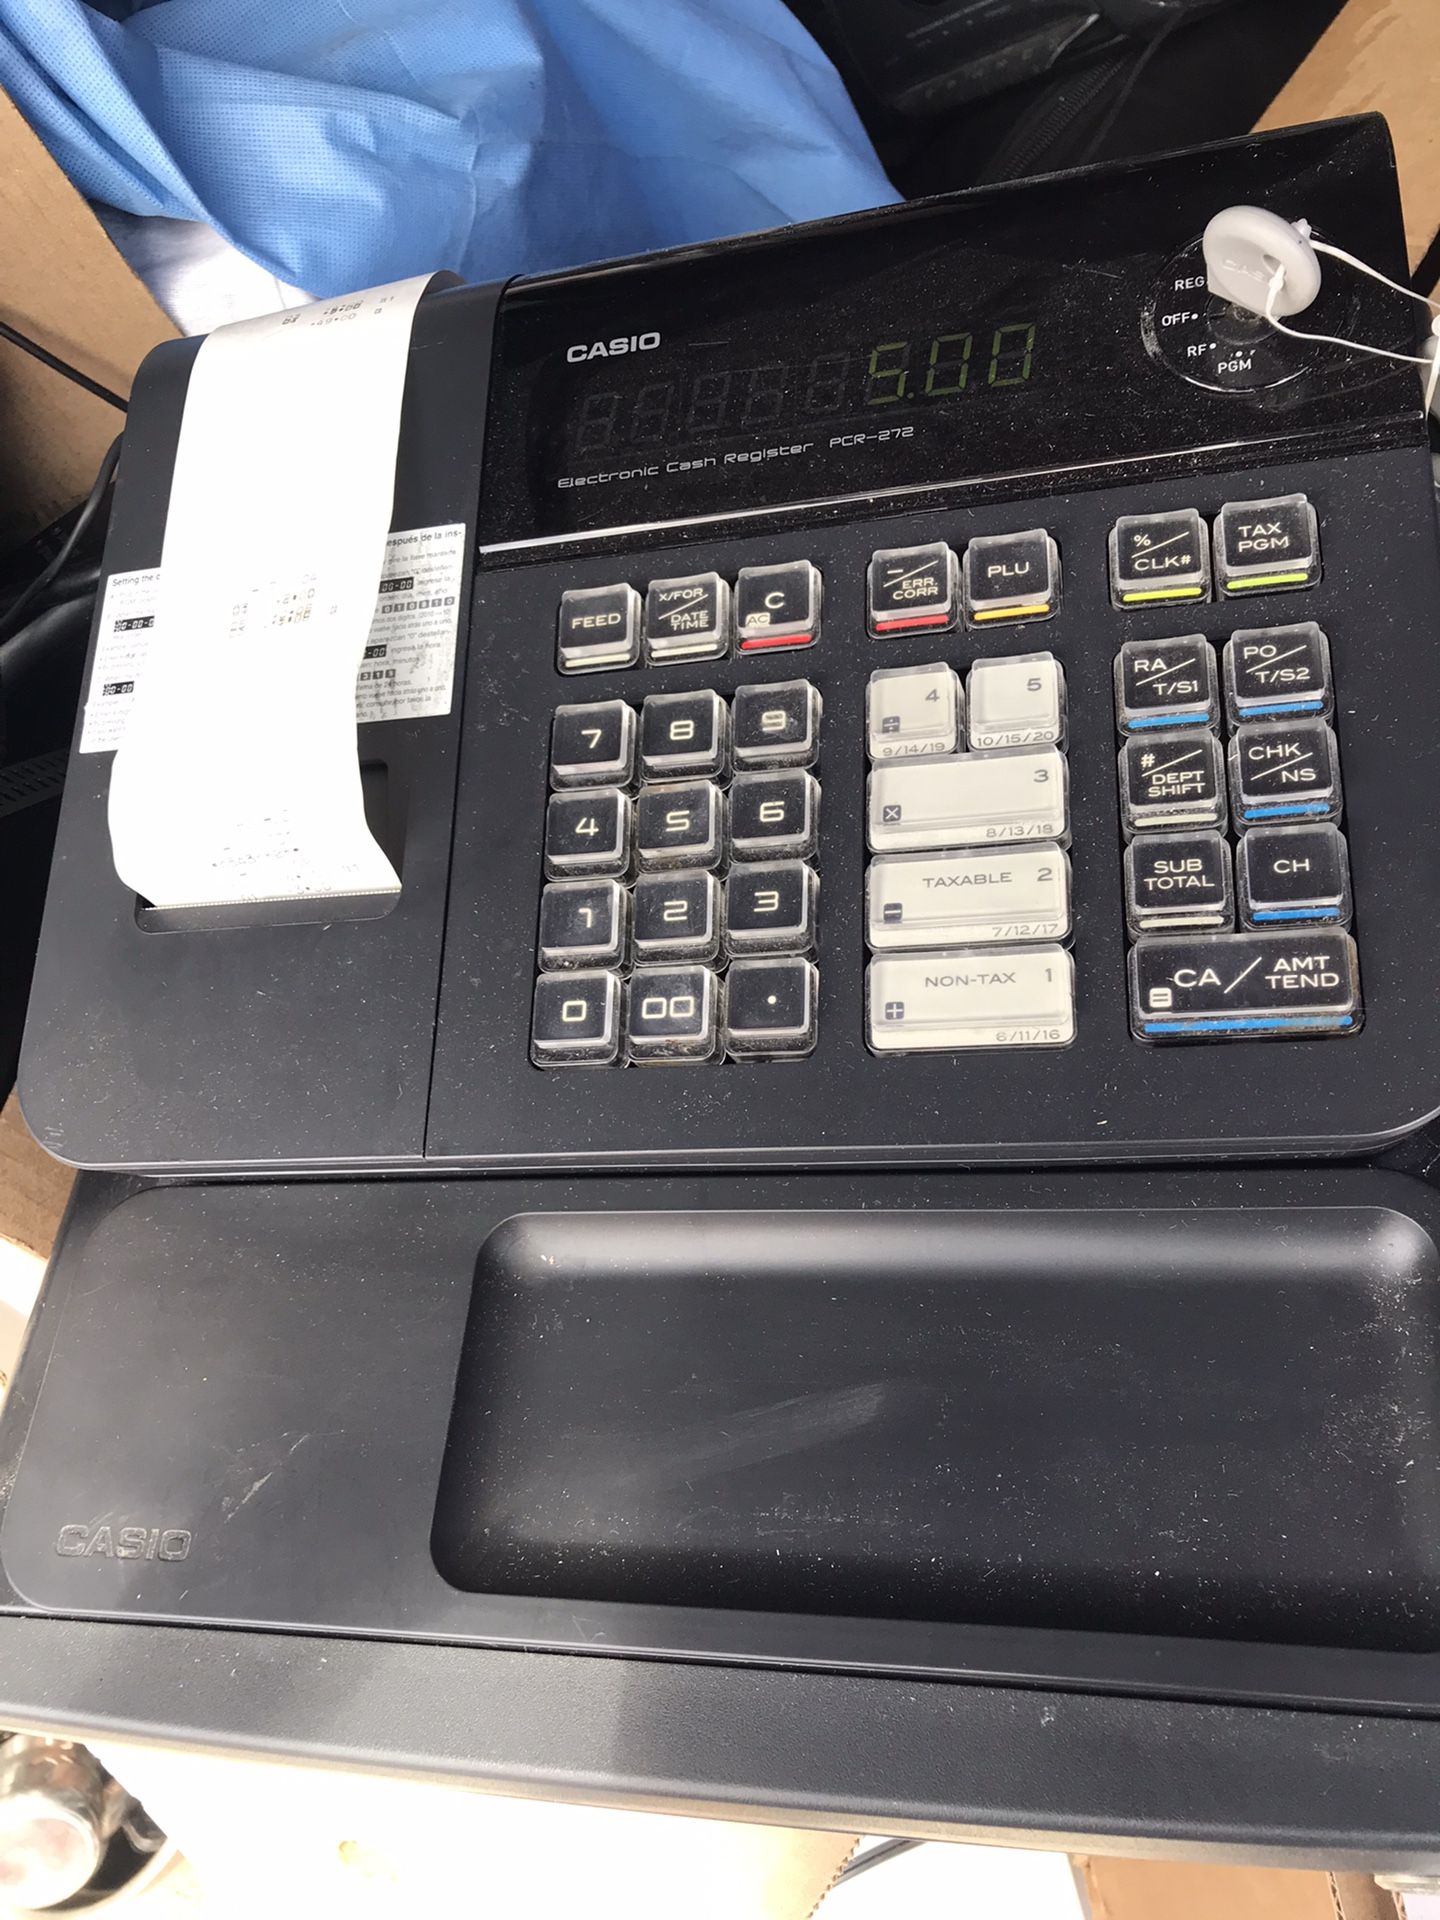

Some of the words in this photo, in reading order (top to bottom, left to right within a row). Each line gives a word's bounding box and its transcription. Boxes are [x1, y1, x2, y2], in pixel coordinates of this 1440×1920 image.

[1174, 275, 1205, 291] REG
[1161, 312, 1191, 327] OFF
[566, 332, 661, 363] CASIO
[1187, 344, 1207, 357] RF
[866, 323, 1035, 405] 5.00
[1217, 359, 1252, 374] PGM
[557, 466, 659, 488] Electronic
[666, 457, 716, 473] Cash
[724, 443, 814, 464] Register
[829, 426, 914, 448] PCR-272
[1238, 522, 1282, 538] TAX
[387, 535, 418, 548] espués
[1133, 534, 1151, 547] %
[1238, 536, 1290, 553] PGM
[987, 561, 1030, 578] PLU
[1134, 555, 1191, 571] CLK#
[112, 577, 139, 587] Setting
[141, 575, 154, 583] the
[658, 588, 704, 602] X/FOR
[765, 592, 785, 609] C
[892, 587, 938, 600] CORR
[572, 613, 621, 629] FEED
[671, 611, 709, 624] DATE
[671, 619, 709, 631] TIME
[748, 614, 769, 626] AC
[1243, 645, 1277, 659] PO
[1134, 658, 1168, 673] RA
[1255, 667, 1310, 684] T/S2
[1027, 678, 1042, 692] 5
[1153, 681, 1198, 696] T/S1
[925, 688, 940, 702] 4
[761, 710, 786, 732] 9
[670, 720, 694, 740] 8
[581, 729, 602, 749] 7
[977, 731, 1054, 748] 10/15/20
[882, 742, 945, 758] 9/14/19
[1248, 742, 1301, 761] CHK
[1141, 753, 1155, 768] #
[1033, 769, 1049, 783] 3
[1152, 771, 1204, 785] DEPT
[1281, 768, 1316, 783] NS
[1148, 783, 1206, 797] SHIFT
[759, 801, 785, 823] 6
[575, 817, 599, 836] 4
[665, 810, 690, 832] 5
[985, 824, 1054, 838] 8/13/18
[1154, 859, 1203, 873] SUB
[1273, 858, 1310, 873] CH
[922, 872, 1012, 888] TAXABLE
[1037, 868, 1053, 882] 2
[1144, 875, 1215, 890] TOTAL
[753, 891, 779, 912] 3
[578, 908, 593, 928] 1
[663, 900, 688, 922] 2
[992, 924, 1058, 938] 7/12/17
[1273, 956, 1330, 972] AMT
[925, 972, 1016, 988] NON-TAX
[1045, 968, 1052, 982] 1
[1265, 973, 1340, 989] TEND
[562, 1000, 587, 1022] 0
[641, 995, 695, 1020] 00
[996, 1029, 1060, 1042] 6/11/16
[56, 1524, 192, 1561] CASIO
